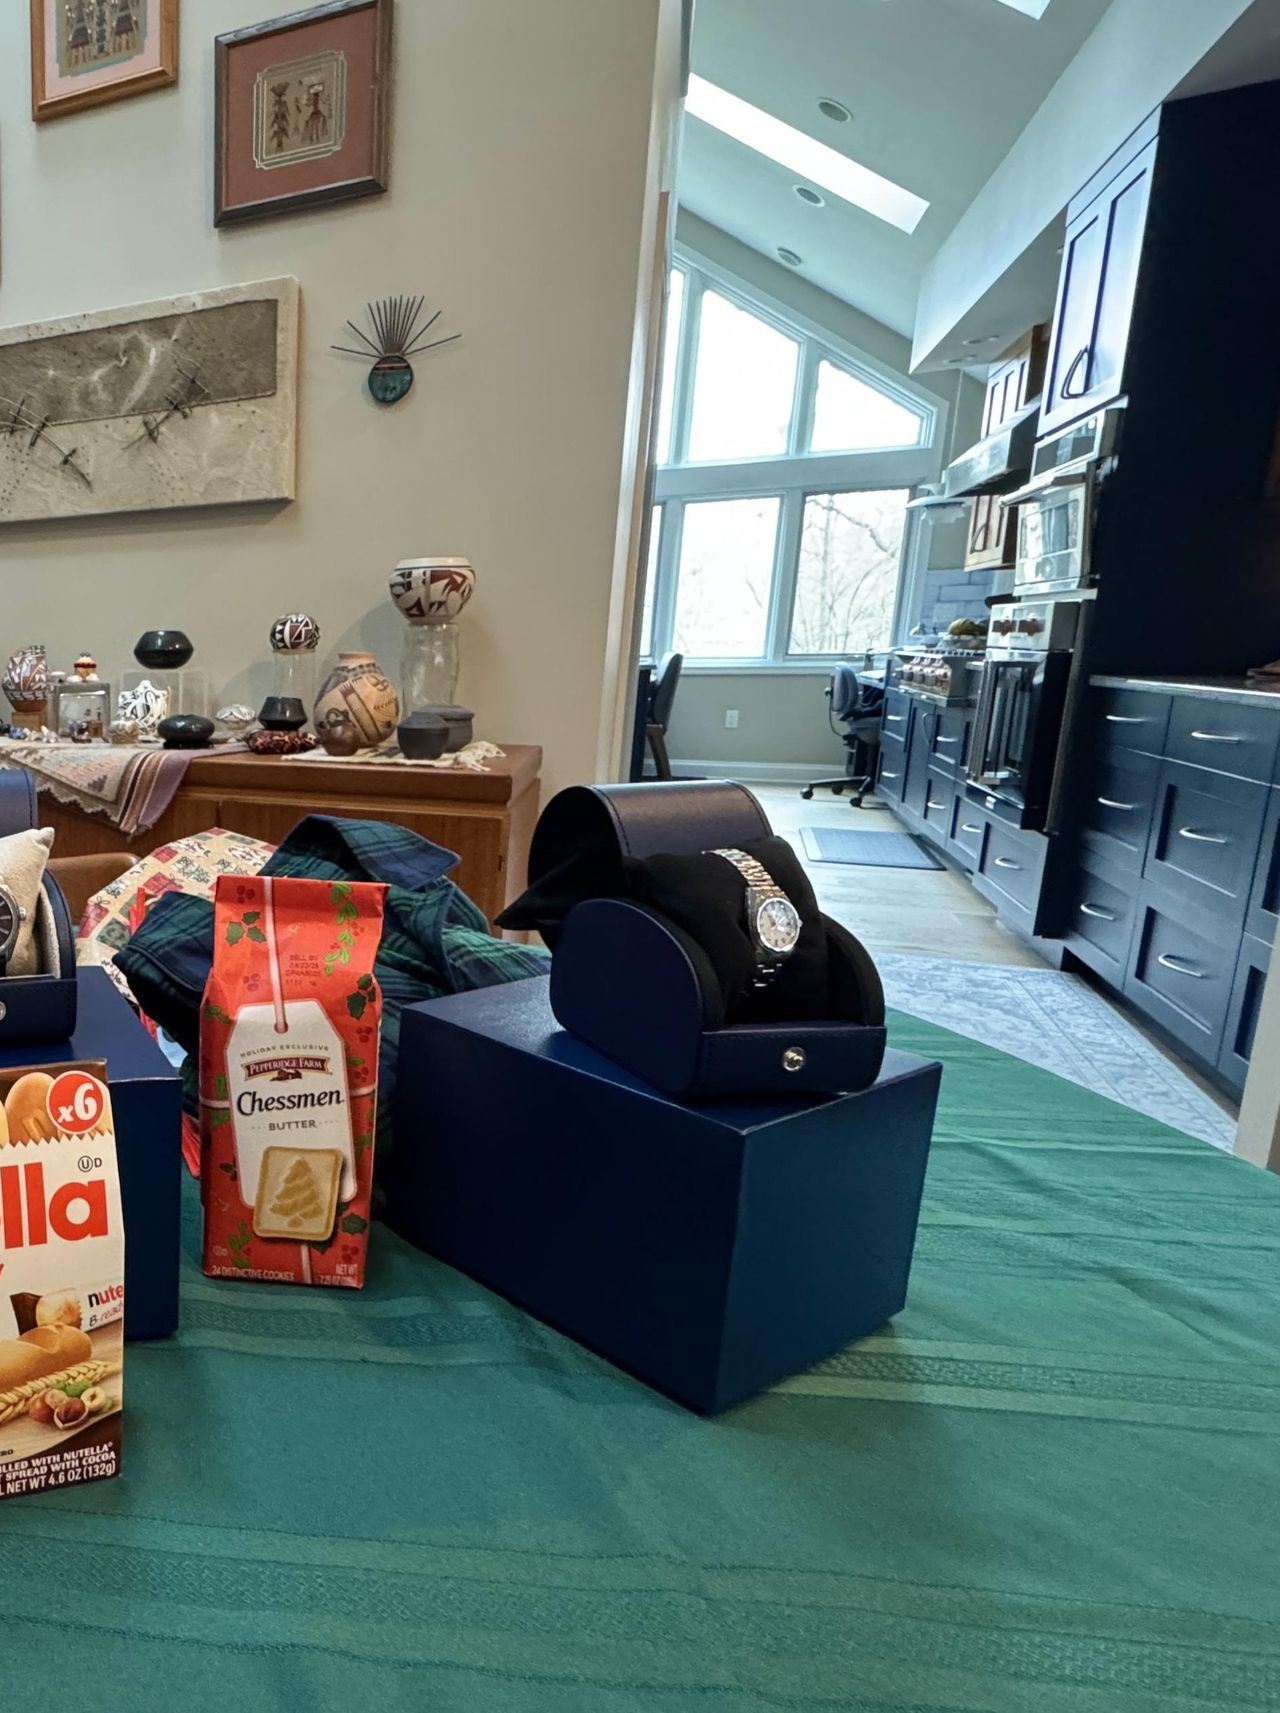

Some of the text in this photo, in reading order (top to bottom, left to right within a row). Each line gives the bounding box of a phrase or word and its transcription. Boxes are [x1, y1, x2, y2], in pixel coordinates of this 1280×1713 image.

[240, 1045, 276, 1058] HOLIDAY
[249, 1058, 322, 1075] PEPPERIDGE FARM
[57, 1082, 98, 1124] x6
[237, 1089, 341, 1116] Chessmen
[269, 1120, 317, 1131] BUTTER
[88, 1285, 123, 1307] nute
[5, 1466, 48, 1481] SPREAD
[51, 1460, 79, 1472] WITH
[82, 1451, 116, 1466] COCOA
[31, 1454, 60, 1467] WITH
[6, 1479, 26, 1494] NET
[29, 1475, 47, 1491] WT
[48, 1471, 65, 1486] 4.6
[67, 1468, 81, 1482] OZ
[83, 1460, 116, 1479] (132g)
